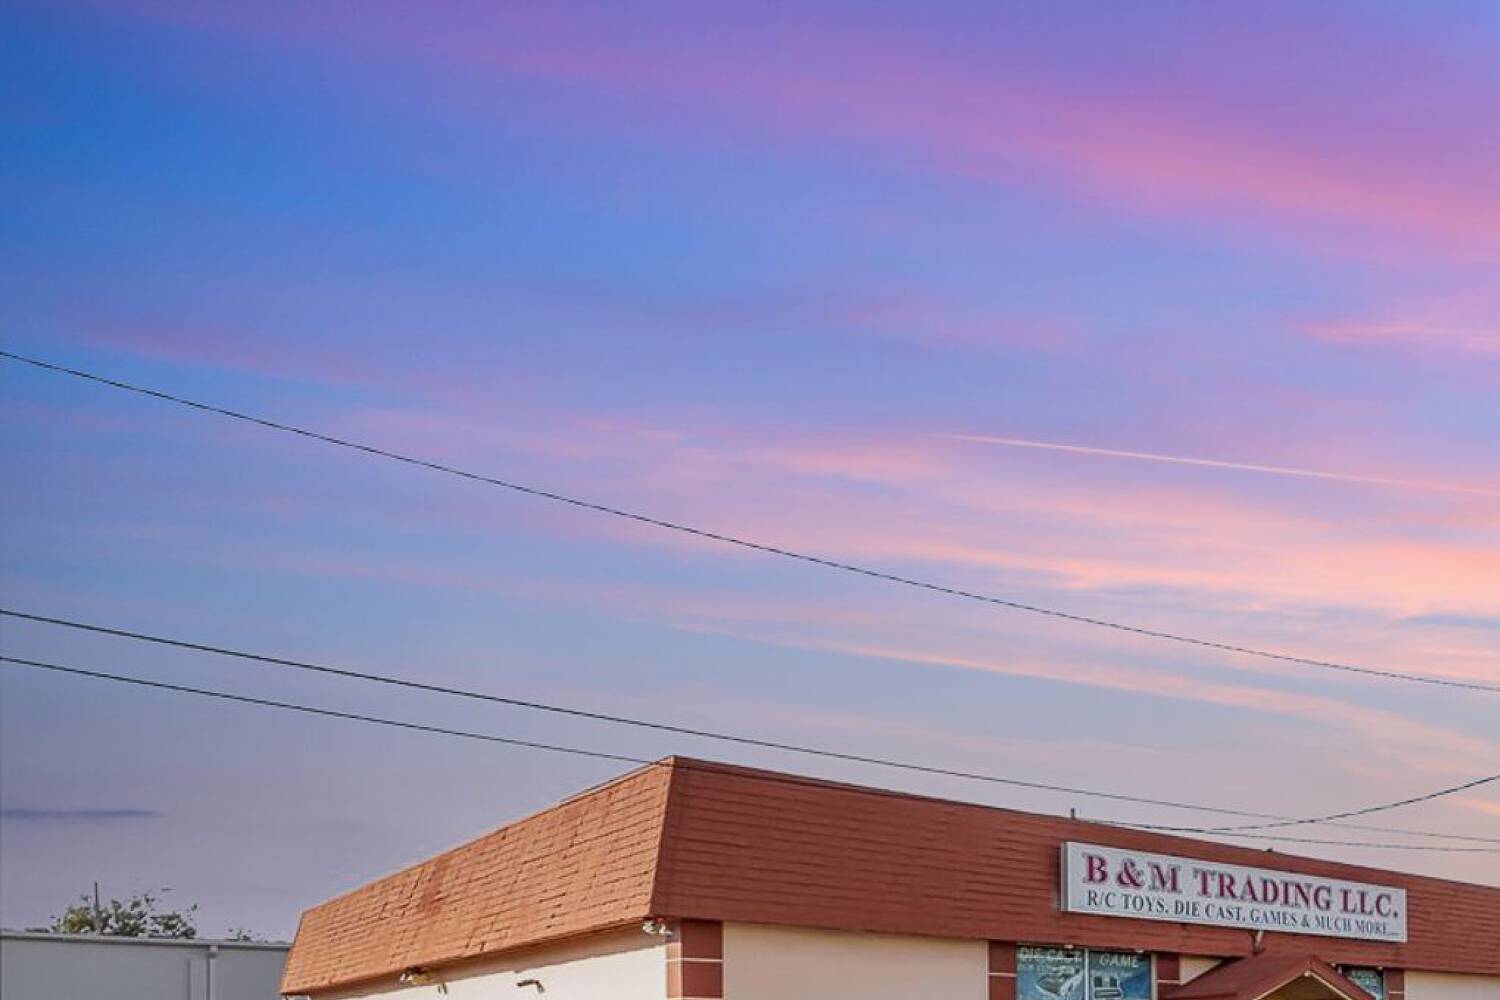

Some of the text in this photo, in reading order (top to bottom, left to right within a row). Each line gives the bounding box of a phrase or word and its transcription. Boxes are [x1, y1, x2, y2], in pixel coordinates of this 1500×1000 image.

[1087, 890, 1118, 908] R/C
[1174, 900, 1201, 918] DIE
[1250, 908, 1299, 928] GAMES
[1300, 914, 1311, 929] &
[1315, 914, 1352, 932] MUCH
[1193, 866, 1332, 911] TRADING
[1340, 888, 1399, 919] LLC.
